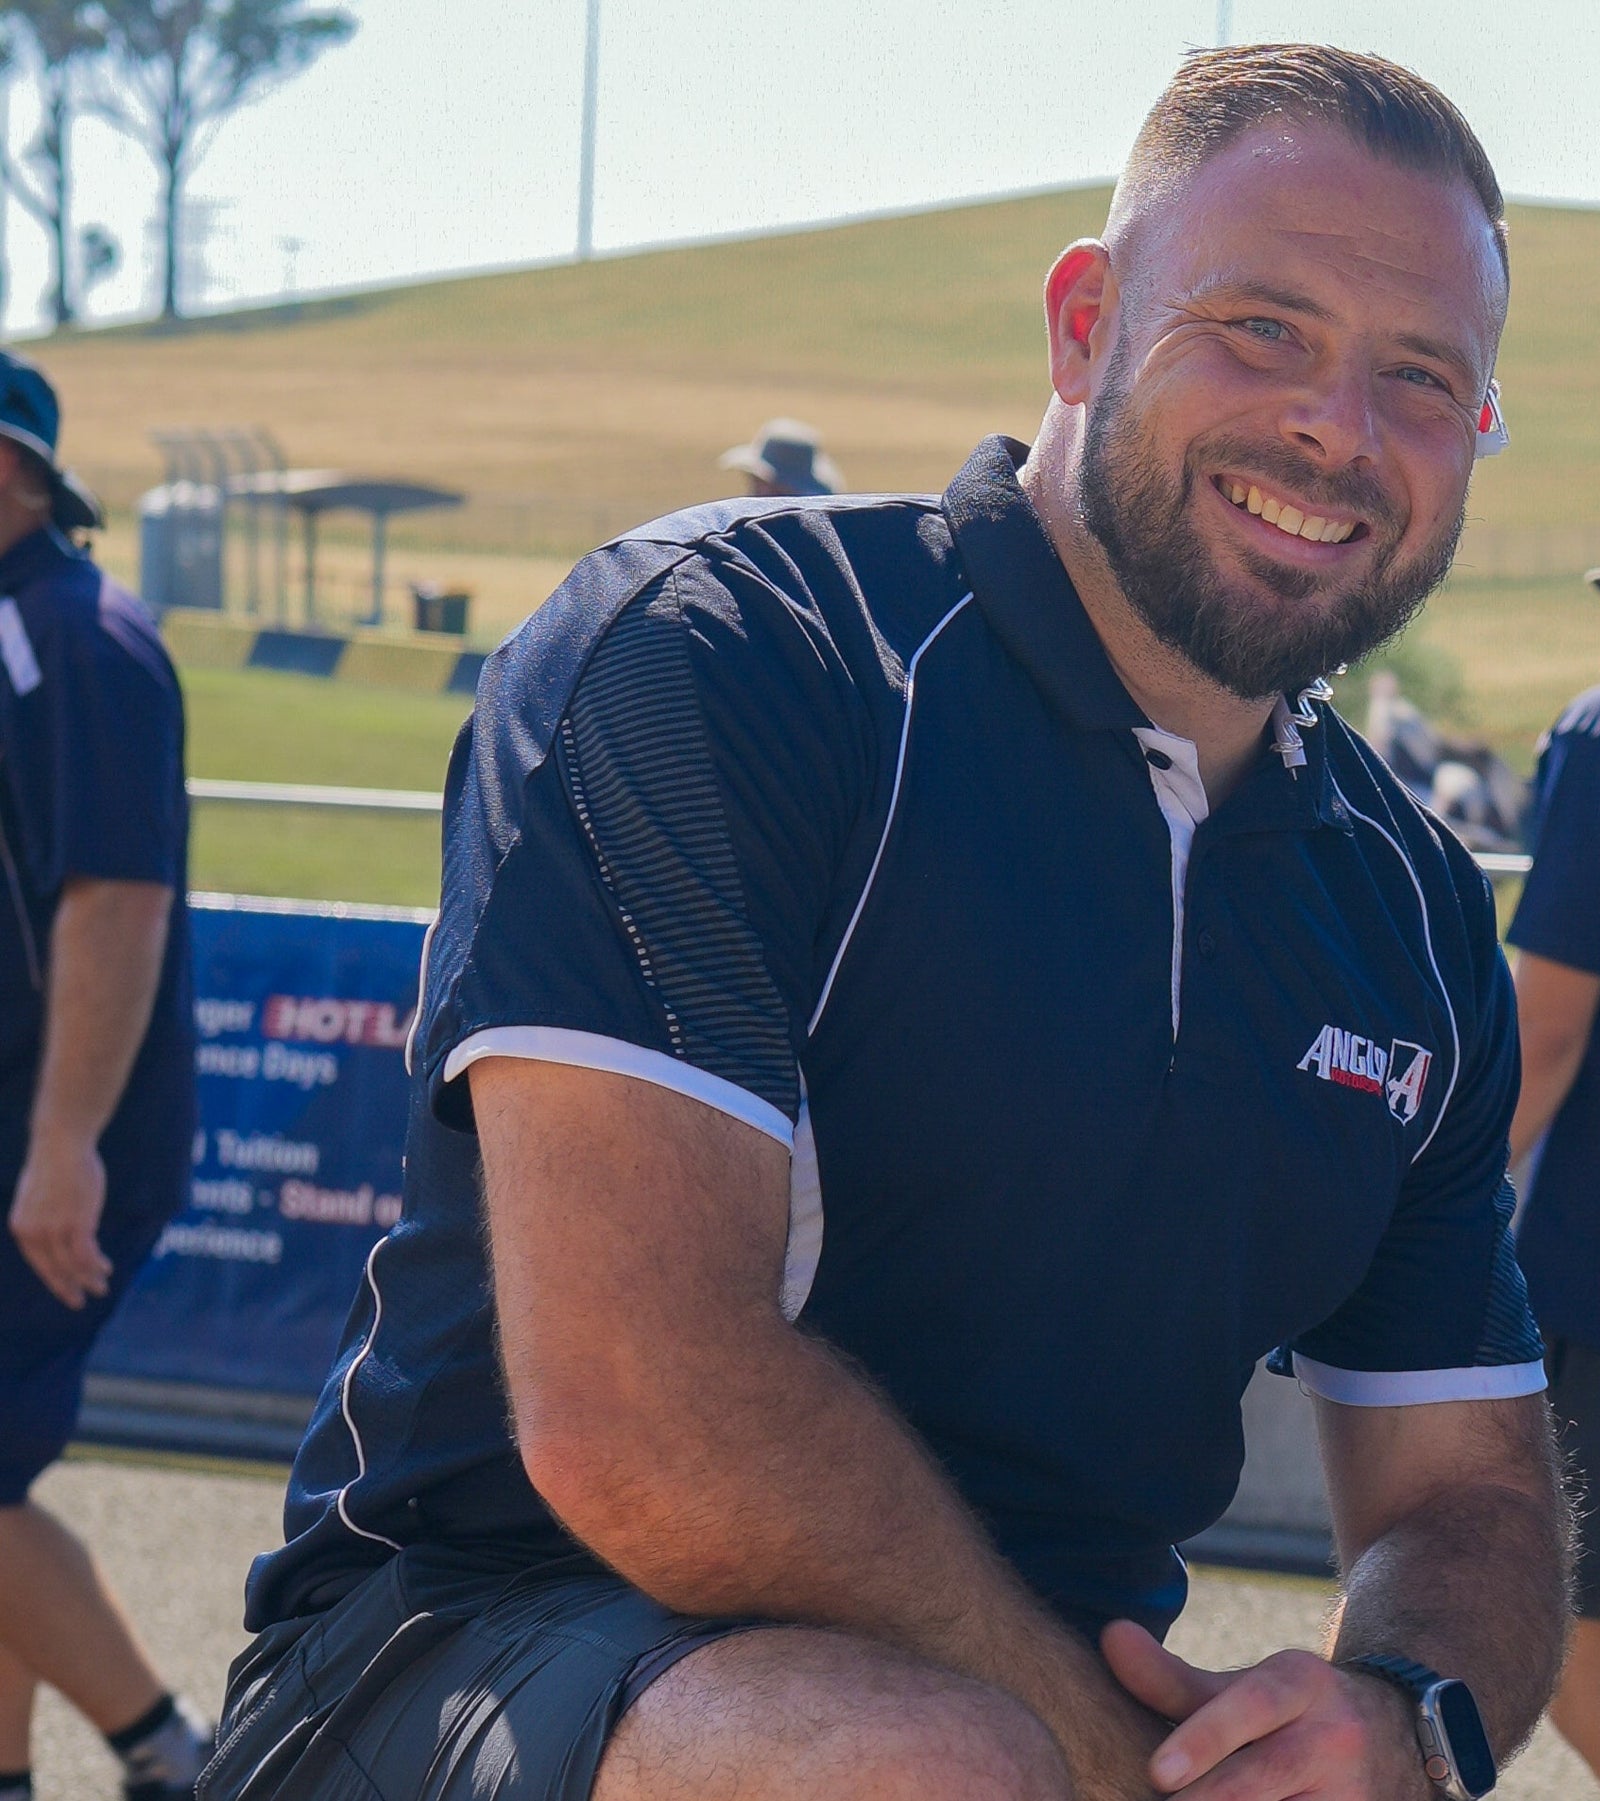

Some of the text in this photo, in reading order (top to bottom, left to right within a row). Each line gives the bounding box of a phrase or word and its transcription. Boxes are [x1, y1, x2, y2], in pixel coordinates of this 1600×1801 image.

[263, 1042, 338, 1090] Days
[1296, 1024, 1388, 1086] ANGLO
[216, 1130, 319, 1173] Tuition
[280, 1180, 373, 1225] Stand
